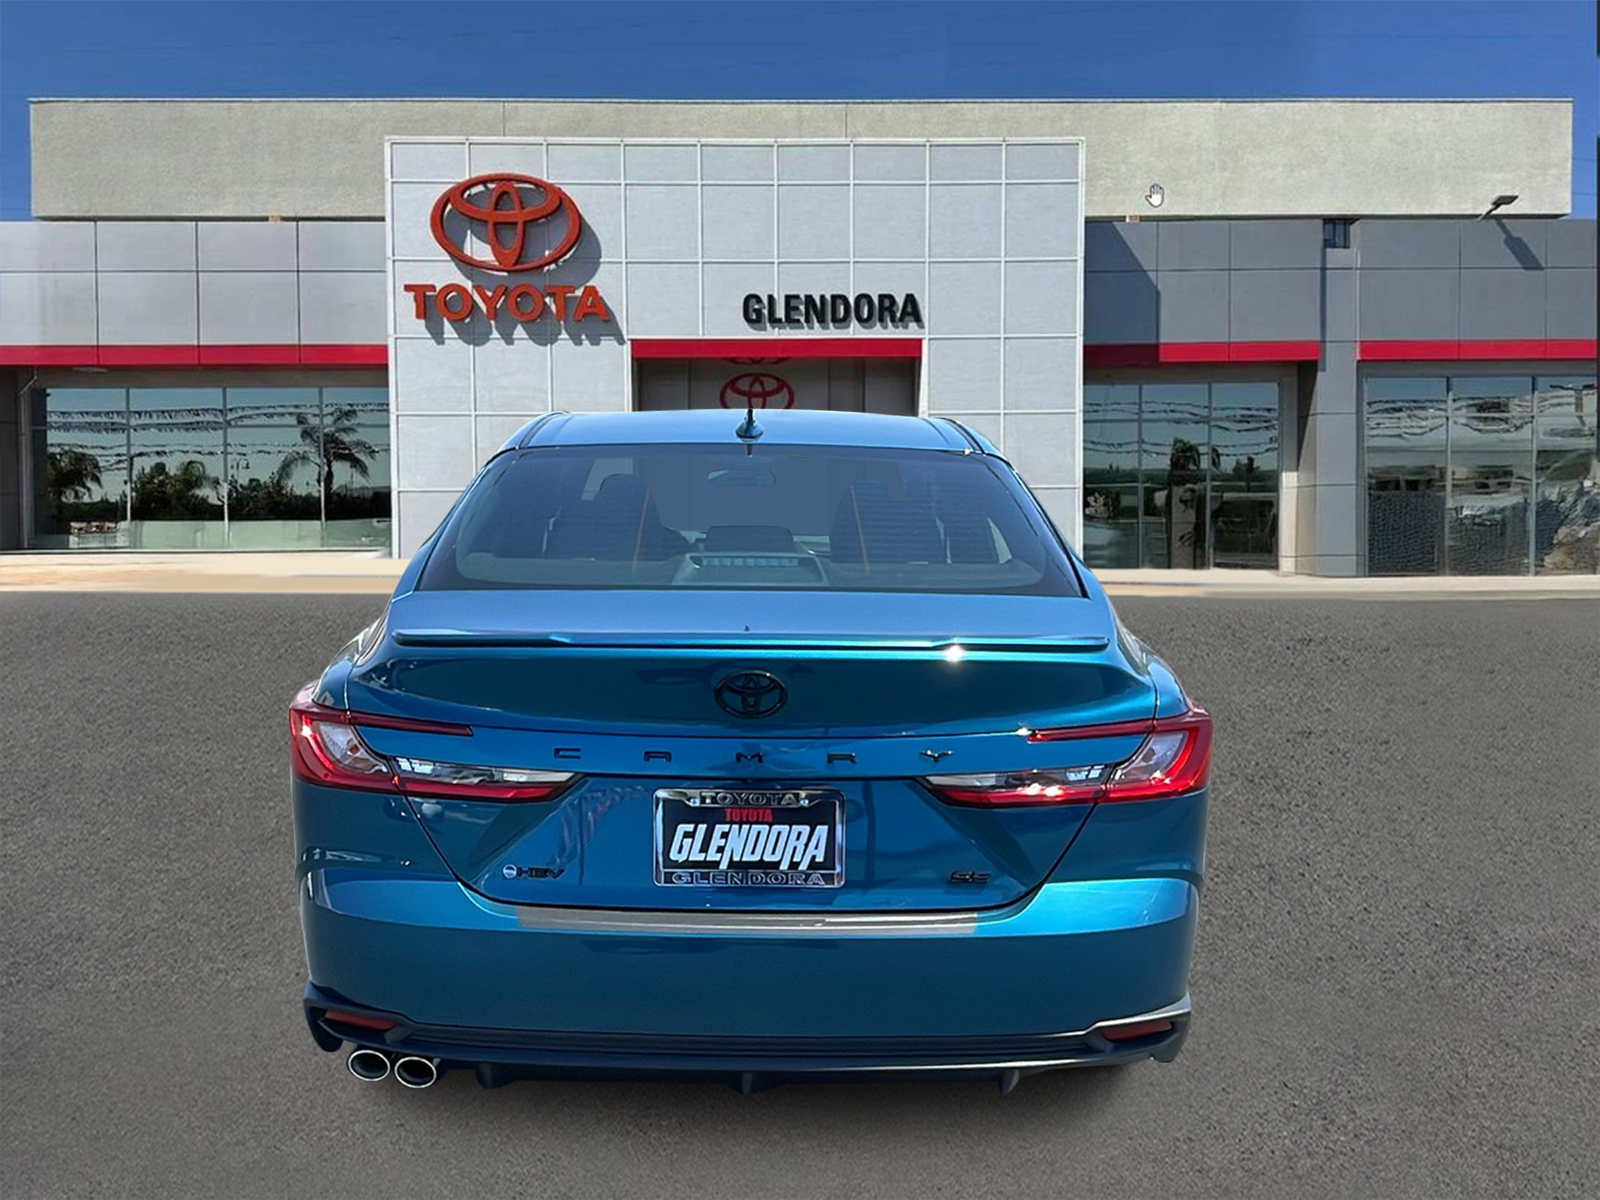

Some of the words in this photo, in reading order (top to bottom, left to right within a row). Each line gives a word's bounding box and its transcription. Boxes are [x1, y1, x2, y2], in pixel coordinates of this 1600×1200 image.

[404, 283, 609, 322] TOYOTA
[743, 293, 921, 324] GLENDORA
[553, 747, 954, 764] CAMRY
[702, 792, 800, 806] TOYOTA
[724, 808, 772, 822] TOYOTA
[669, 824, 829, 870] GLENDORA
[671, 872, 826, 885] GLENDORA
